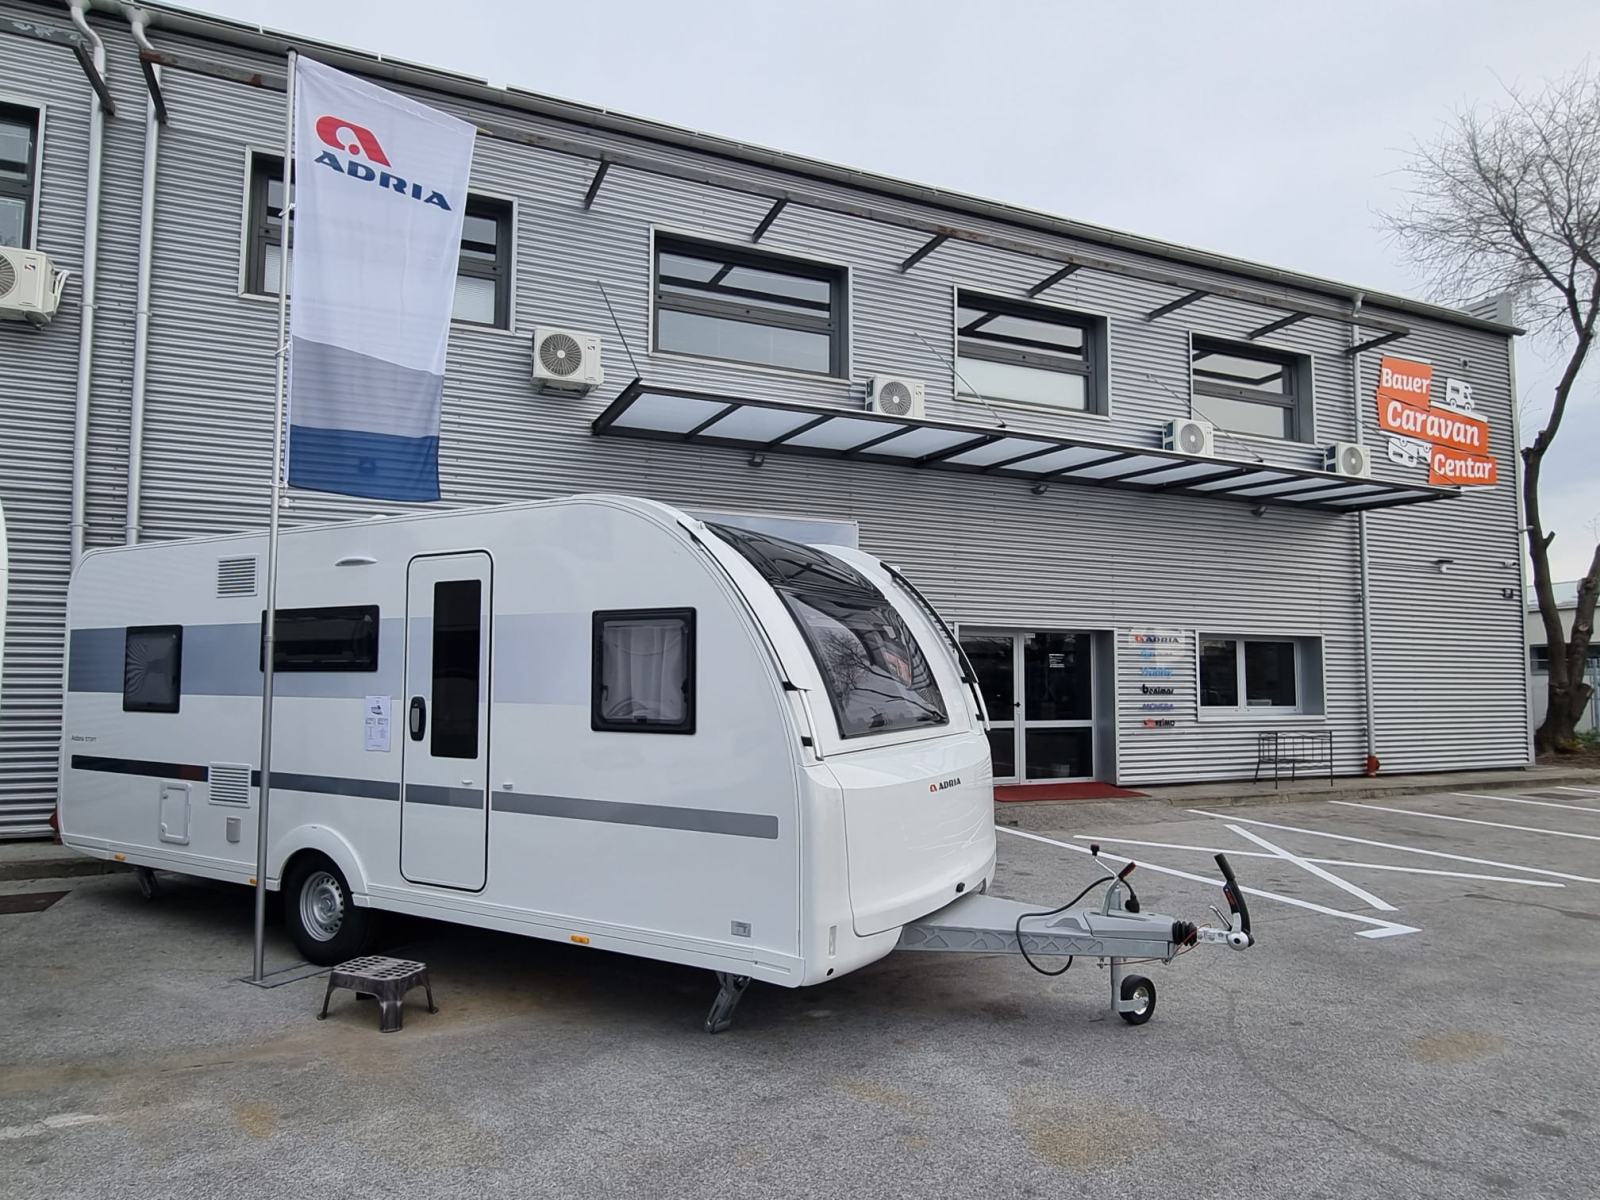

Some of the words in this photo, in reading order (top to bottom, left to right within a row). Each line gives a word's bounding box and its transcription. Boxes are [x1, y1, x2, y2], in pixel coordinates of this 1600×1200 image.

[314, 150, 452, 211] ADRIA
[1381, 367, 1431, 394] Bauer
[1387, 400, 1480, 447] Caravan
[1433, 453, 1492, 480] Centar
[1146, 634, 1180, 644] ADRIA
[939, 777, 962, 791] ADRIA
